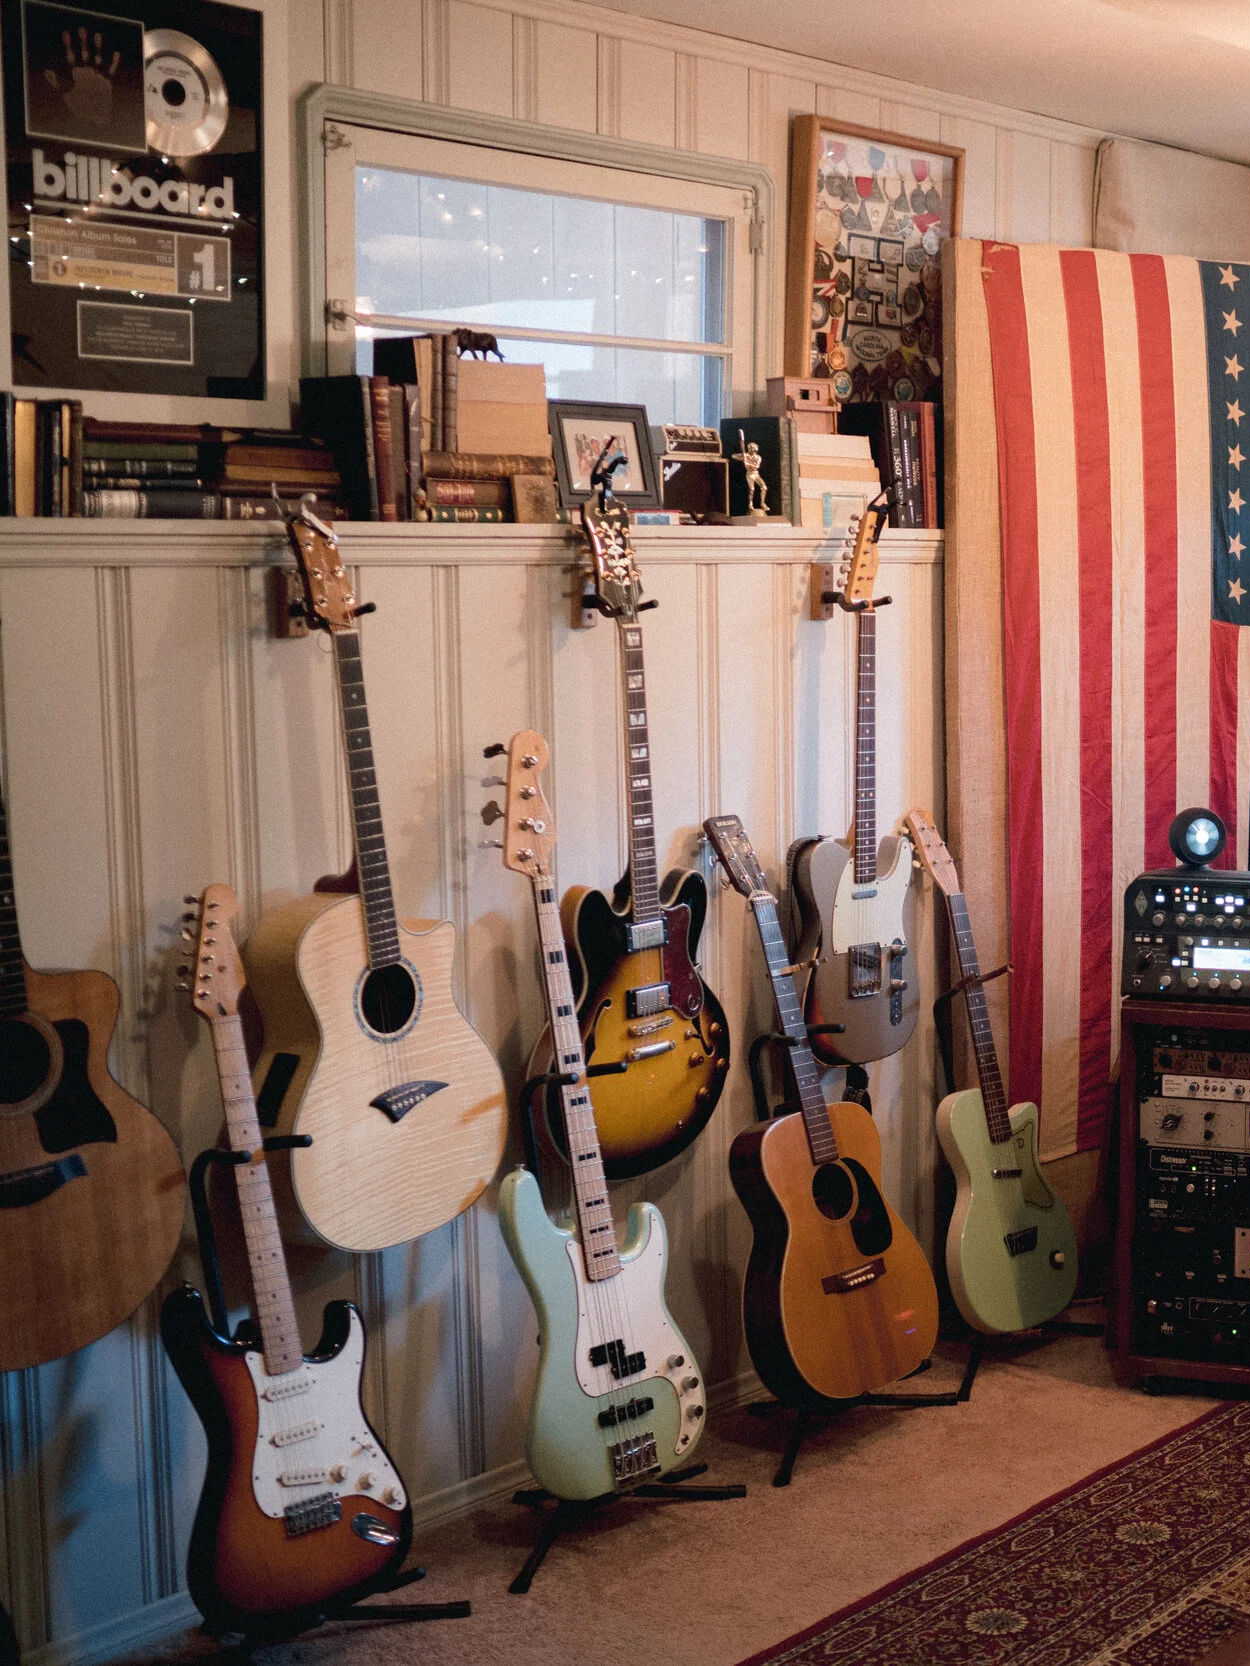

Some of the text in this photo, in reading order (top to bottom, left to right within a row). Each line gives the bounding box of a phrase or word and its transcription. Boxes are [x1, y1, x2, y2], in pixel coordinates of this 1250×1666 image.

[32, 148, 234, 219] billboard
[37, 224, 137, 245] Christian Album Sales
[189, 244, 215, 291] #1
[1160, 1154, 1187, 1165] Distressor
